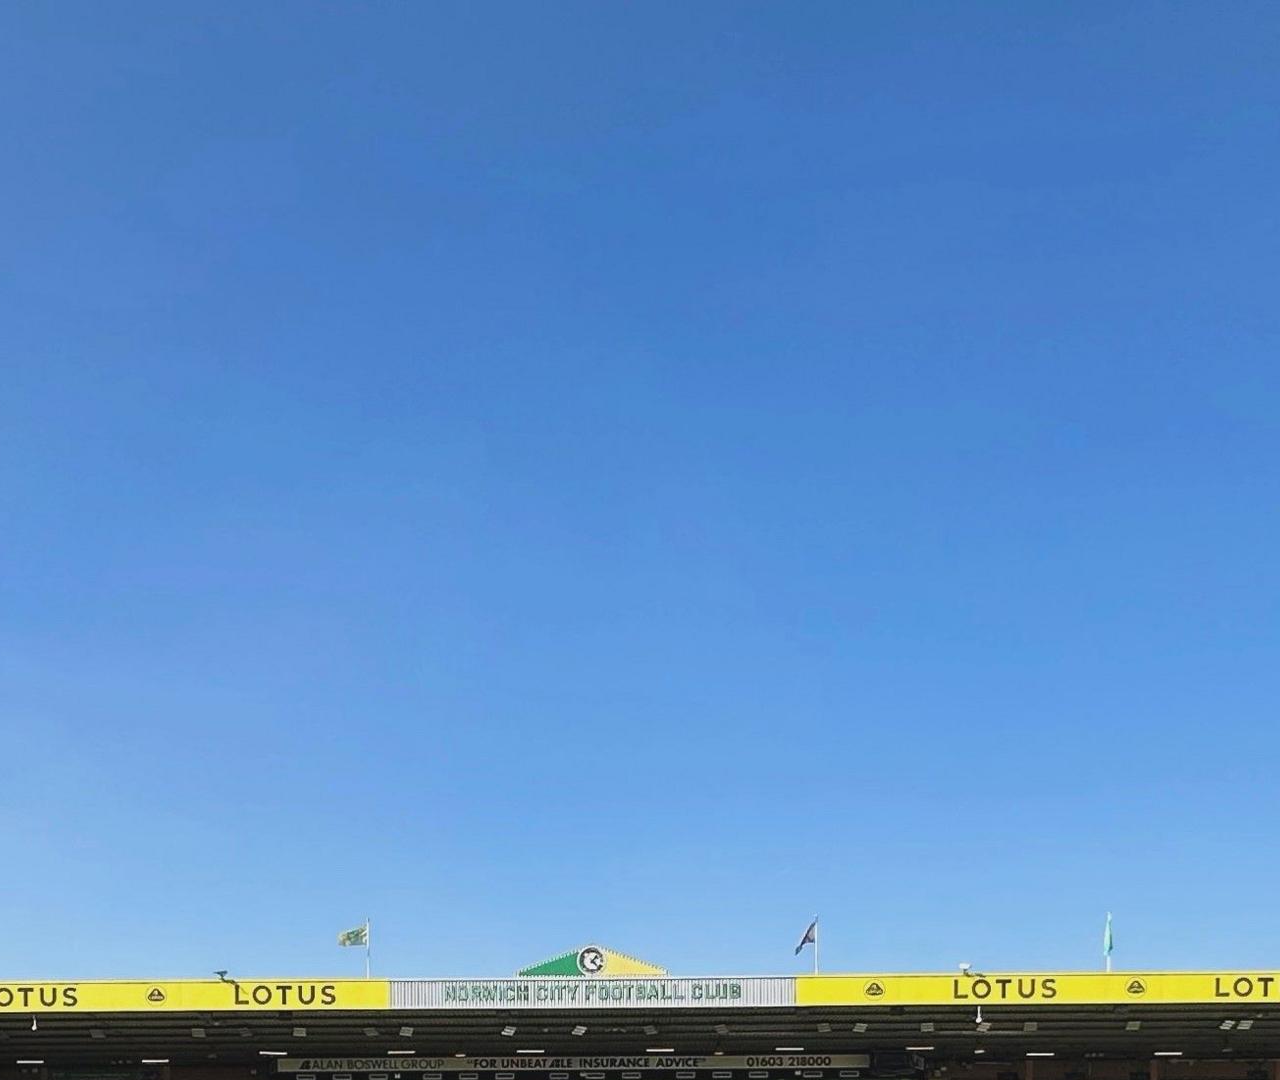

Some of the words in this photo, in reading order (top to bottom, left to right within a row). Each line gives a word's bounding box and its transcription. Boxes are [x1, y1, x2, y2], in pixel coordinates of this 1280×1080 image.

[234, 985, 337, 1005] LOTUS
[444, 985, 529, 1001] NORWICH
[536, 985, 577, 1001] CITY
[585, 984, 683, 1000] FOOTBALL
[691, 984, 741, 1000] CLUB
[953, 979, 1057, 999] LOTUS
[311, 1060, 343, 1070] ALAN
[347, 1059, 400, 1070] BOSWELL
[401, 1058, 445, 1070] GROUP
[579, 1057, 650, 1068] INSURANCE
[746, 1056, 784, 1067] 01603
[787, 1056, 832, 1067] 218000
